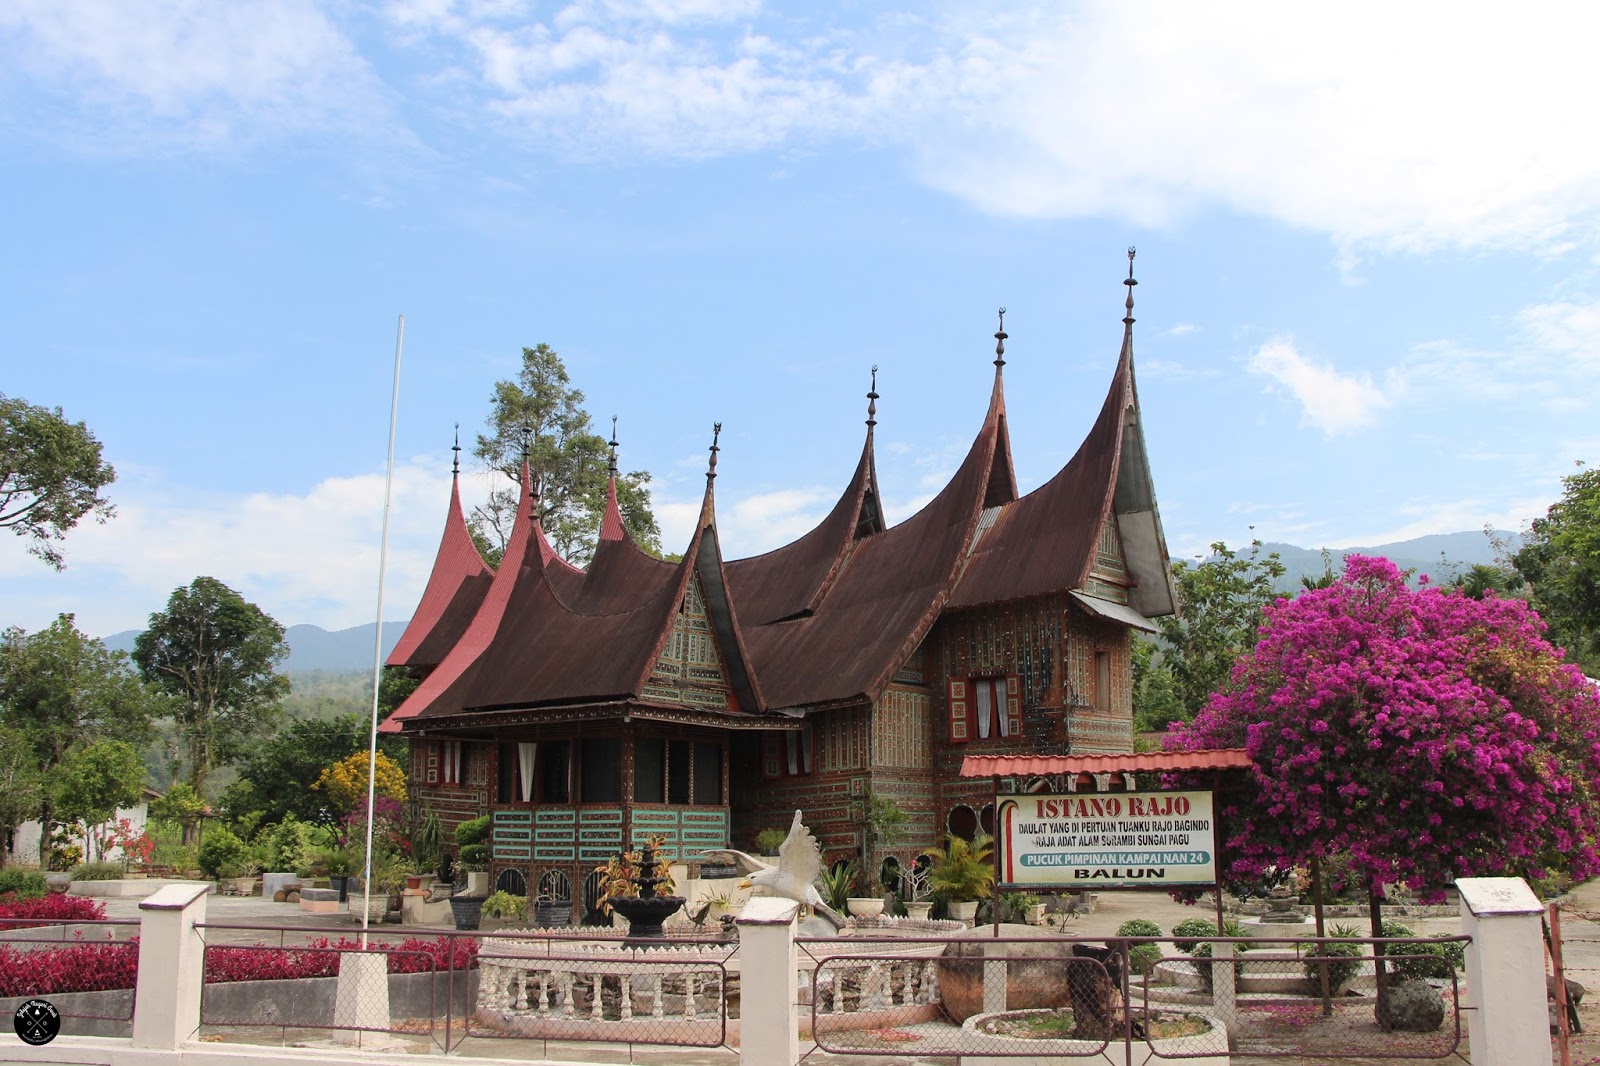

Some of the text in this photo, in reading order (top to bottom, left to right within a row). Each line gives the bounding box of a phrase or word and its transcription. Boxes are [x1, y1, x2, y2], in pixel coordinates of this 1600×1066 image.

[1036, 796, 1191, 818] ISTANO RAJO
[1018, 820, 1209, 834] DAULAT YANG DI PERTUAN TUANKU RAJO BAGINDO
[1036, 833, 1189, 847] RAJA ADAT ALAM SURAMBI SUNGAI PAGU
[1027, 852, 1203, 865] PUCUK PIMPINAN KAMPAI NAN 24
[1074, 868, 1165, 878] BALUN
